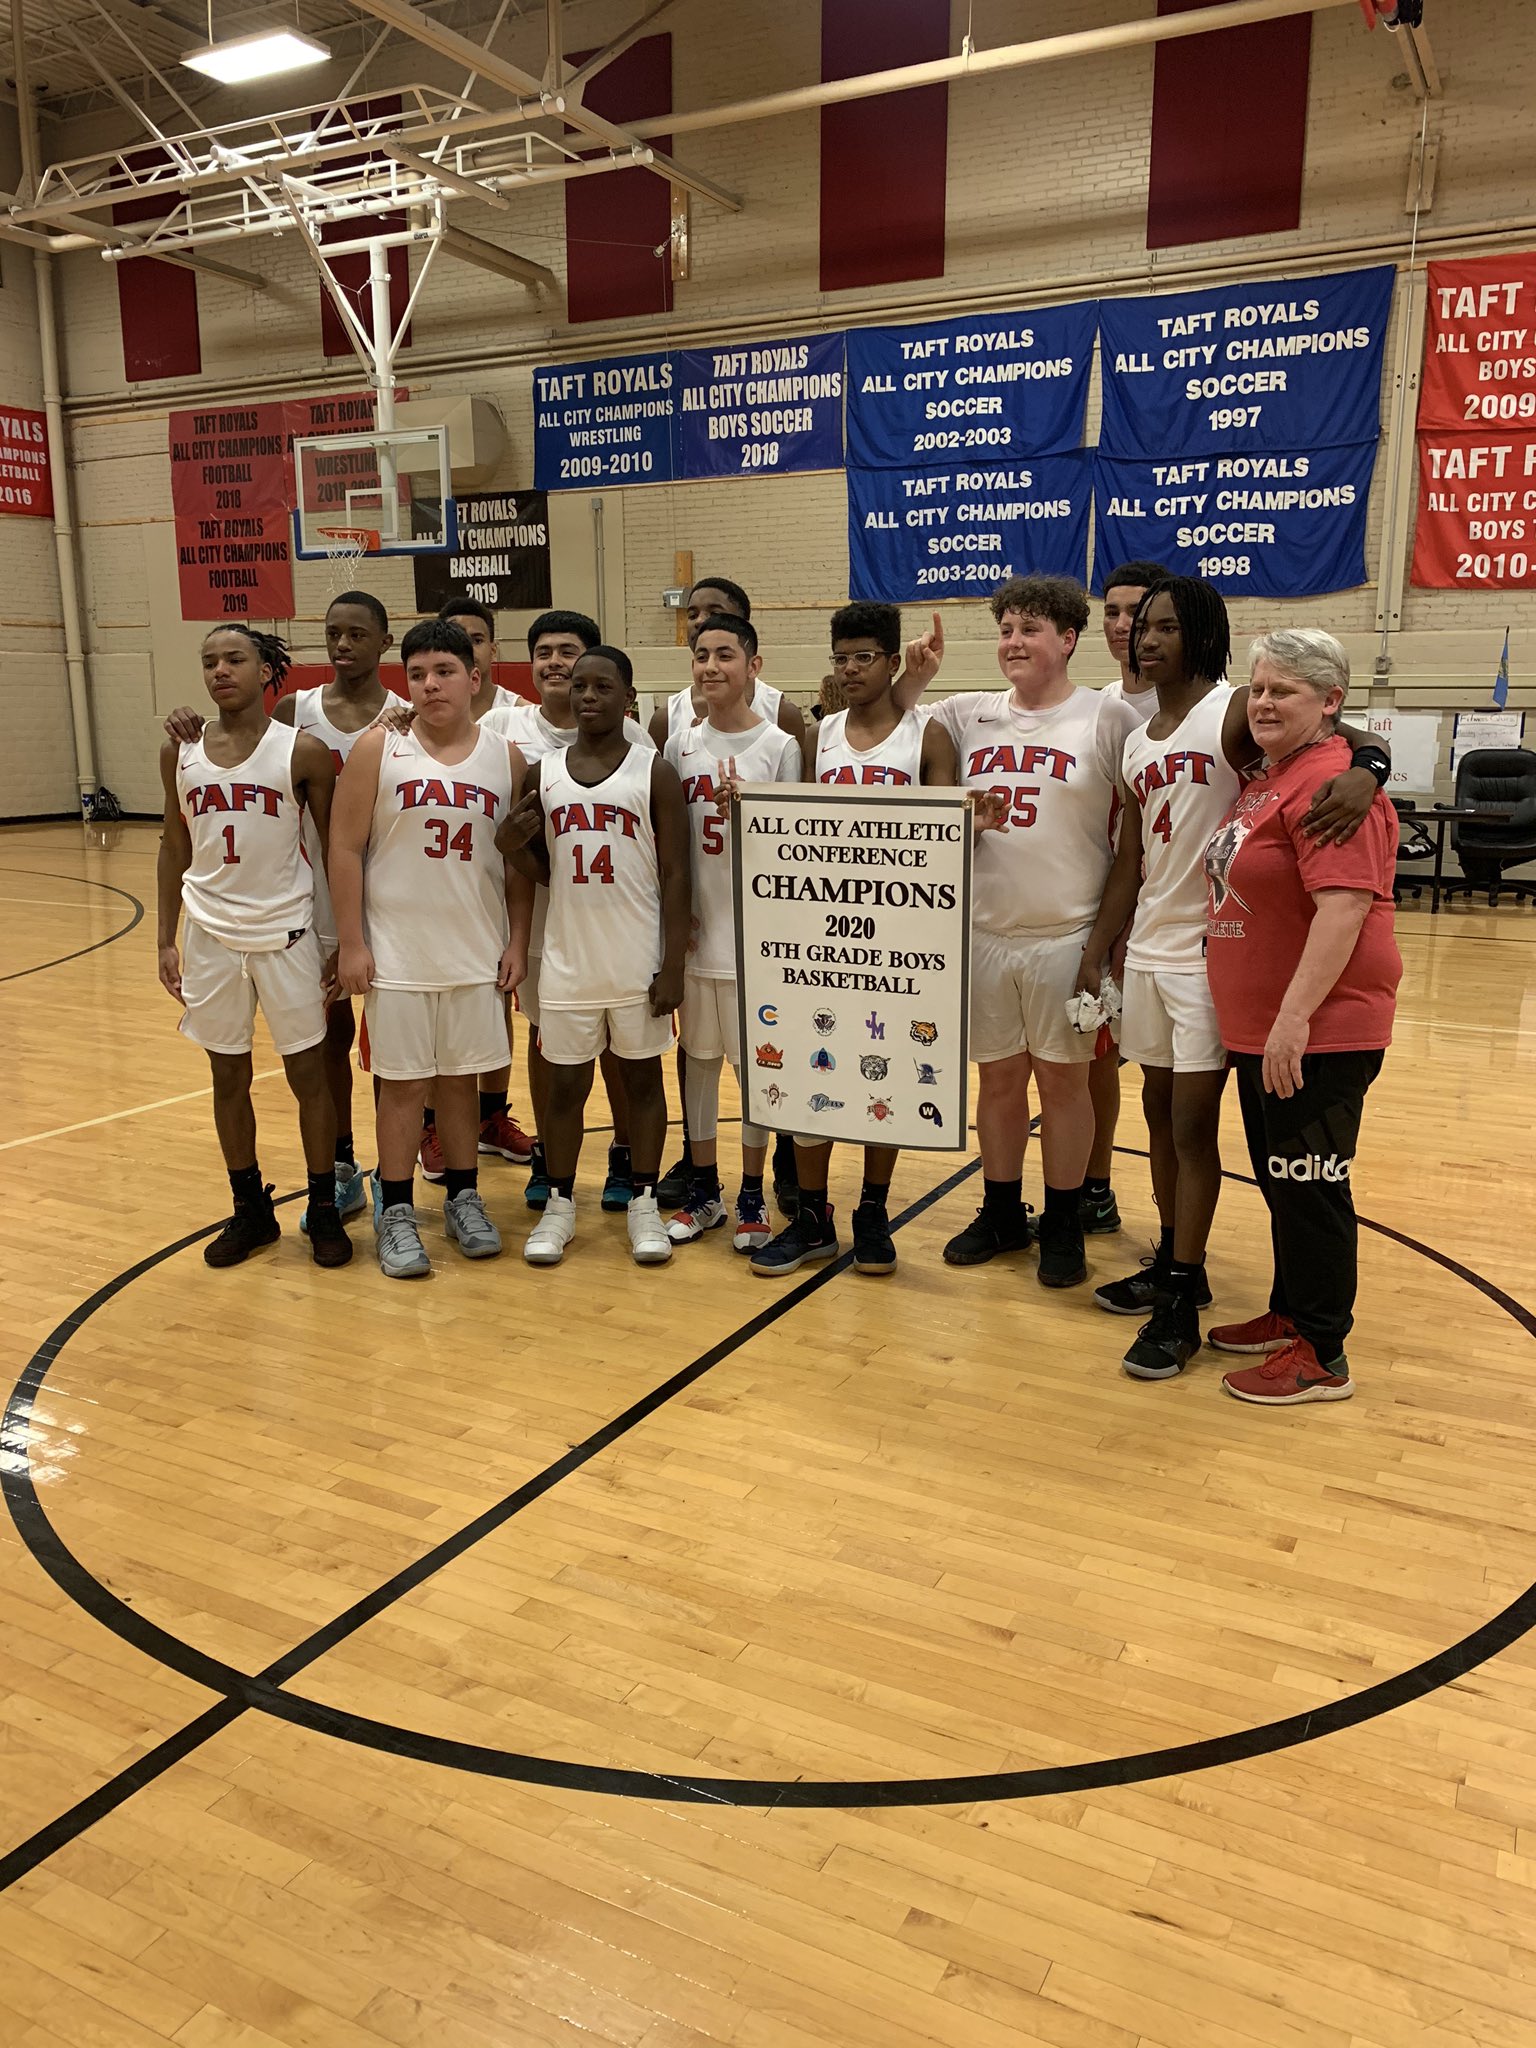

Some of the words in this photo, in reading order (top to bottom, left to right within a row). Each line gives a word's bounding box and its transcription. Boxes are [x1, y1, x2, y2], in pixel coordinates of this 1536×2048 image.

[1437, 281, 1524, 319] TAFT
[1158, 311, 1216, 338] TAFT
[1224, 300, 1319, 329] ROYALS
[901, 337, 949, 360] TAFT
[955, 328, 1034, 354] ROYALS
[1115, 353, 1155, 373] ALL
[1163, 344, 1217, 370] CITY
[1226, 327, 1370, 362] CHAMPIONS
[1435, 332, 1470, 353] ALL
[1476, 329, 1528, 352] CITY
[712, 352, 748, 378] TAFT
[751, 344, 809, 376] ROYALS
[1478, 357, 1536, 382] BOYS
[537, 373, 586, 402] TAFT
[592, 362, 673, 397] ROYALS
[861, 375, 897, 393] ALL
[903, 370, 949, 391] CITY
[954, 357, 1073, 386] CHAMPIONS
[1185, 371, 1287, 400] SOCCER
[682, 386, 707, 412] ALL
[709, 382, 744, 409] CITY
[746, 372, 842, 406] CHAMPIONS
[310, 402, 335, 425] TAFT
[538, 412, 561, 428] ALL
[563, 408, 592, 427] CITY
[595, 399, 674, 423] CHAMPIONS
[925, 396, 1003, 420] SOCCER
[1208, 406, 1262, 431] 1997
[193, 415, 217, 435] TAFT
[219, 411, 258, 433] ROYALS
[569, 425, 642, 448] WRESTLING
[708, 413, 748, 440] BOYS
[750, 407, 813, 437] SOCCER
[173, 443, 191, 462] ALL
[192, 440, 215, 460] CITY
[218, 435, 282, 459] CHAMPIONS
[913, 427, 1012, 451] 2002-2003
[0, 447, 47, 465] MPIONS
[560, 450, 653, 478] 2009-2010
[741, 441, 780, 468] 2018
[1427, 445, 1513, 479] TAFT
[0, 464, 41, 481] ETBALL
[202, 463, 253, 485] FOOTBALL
[902, 476, 950, 497] TAFT
[956, 470, 1033, 492] ROYALS
[1152, 462, 1210, 486] TAFT
[1217, 457, 1310, 480] ROYALS
[215, 489, 242, 509] 2018
[470, 498, 518, 523] ROYALS
[1106, 498, 1146, 518] ALL
[1154, 493, 1209, 517] CITY
[1216, 484, 1356, 511] CHAMPIONS
[1427, 492, 1460, 513] ALL
[1466, 491, 1517, 512] CITY
[864, 512, 899, 529] ALL
[905, 506, 949, 527] CITY
[957, 499, 1072, 522] CHAMPIONS
[198, 520, 222, 539] TAFT
[224, 518, 264, 538] ROYALS
[467, 523, 547, 550] CHAMPIONS
[1176, 523, 1276, 548] SOCCER
[1469, 519, 1526, 541] BOYS
[180, 546, 197, 565] ALL
[198, 545, 221, 564] CITY
[223, 541, 288, 563] CHAMPIONS
[927, 533, 1002, 555] SOCCER
[208, 568, 258, 589] FOOTBALL
[450, 554, 512, 578] BASEBALL
[917, 564, 1013, 585] 2003-2004
[1198, 556, 1251, 578] 1998
[222, 593, 248, 613] 2019
[466, 582, 498, 603] 2019
[967, 745, 1077, 783] TAFT
[682, 774, 716, 805] TA
[1133, 751, 1216, 809] TAFT
[186, 783, 284, 818] TAFT
[396, 779, 500, 820] TAFT
[550, 803, 640, 840] TAFT
[747, 816, 790, 835] ALL
[794, 818, 844, 837] CITY
[847, 820, 961, 842] ATHLETIC
[1152, 799, 1172, 843] 4
[222, 825, 240, 864] 1
[424, 818, 473, 862] 34
[702, 815, 725, 855] 5
[572, 844, 615, 884] 14
[777, 843, 928, 868] CONFERENCE
[751, 873, 956, 910] CHAMPIONS
[825, 914, 876, 940] 2020
[760, 940, 801, 961] 8TH
[806, 944, 883, 967] GRADE
[888, 950, 946, 971] BOYS
[782, 967, 921, 996] BASKETBALL
